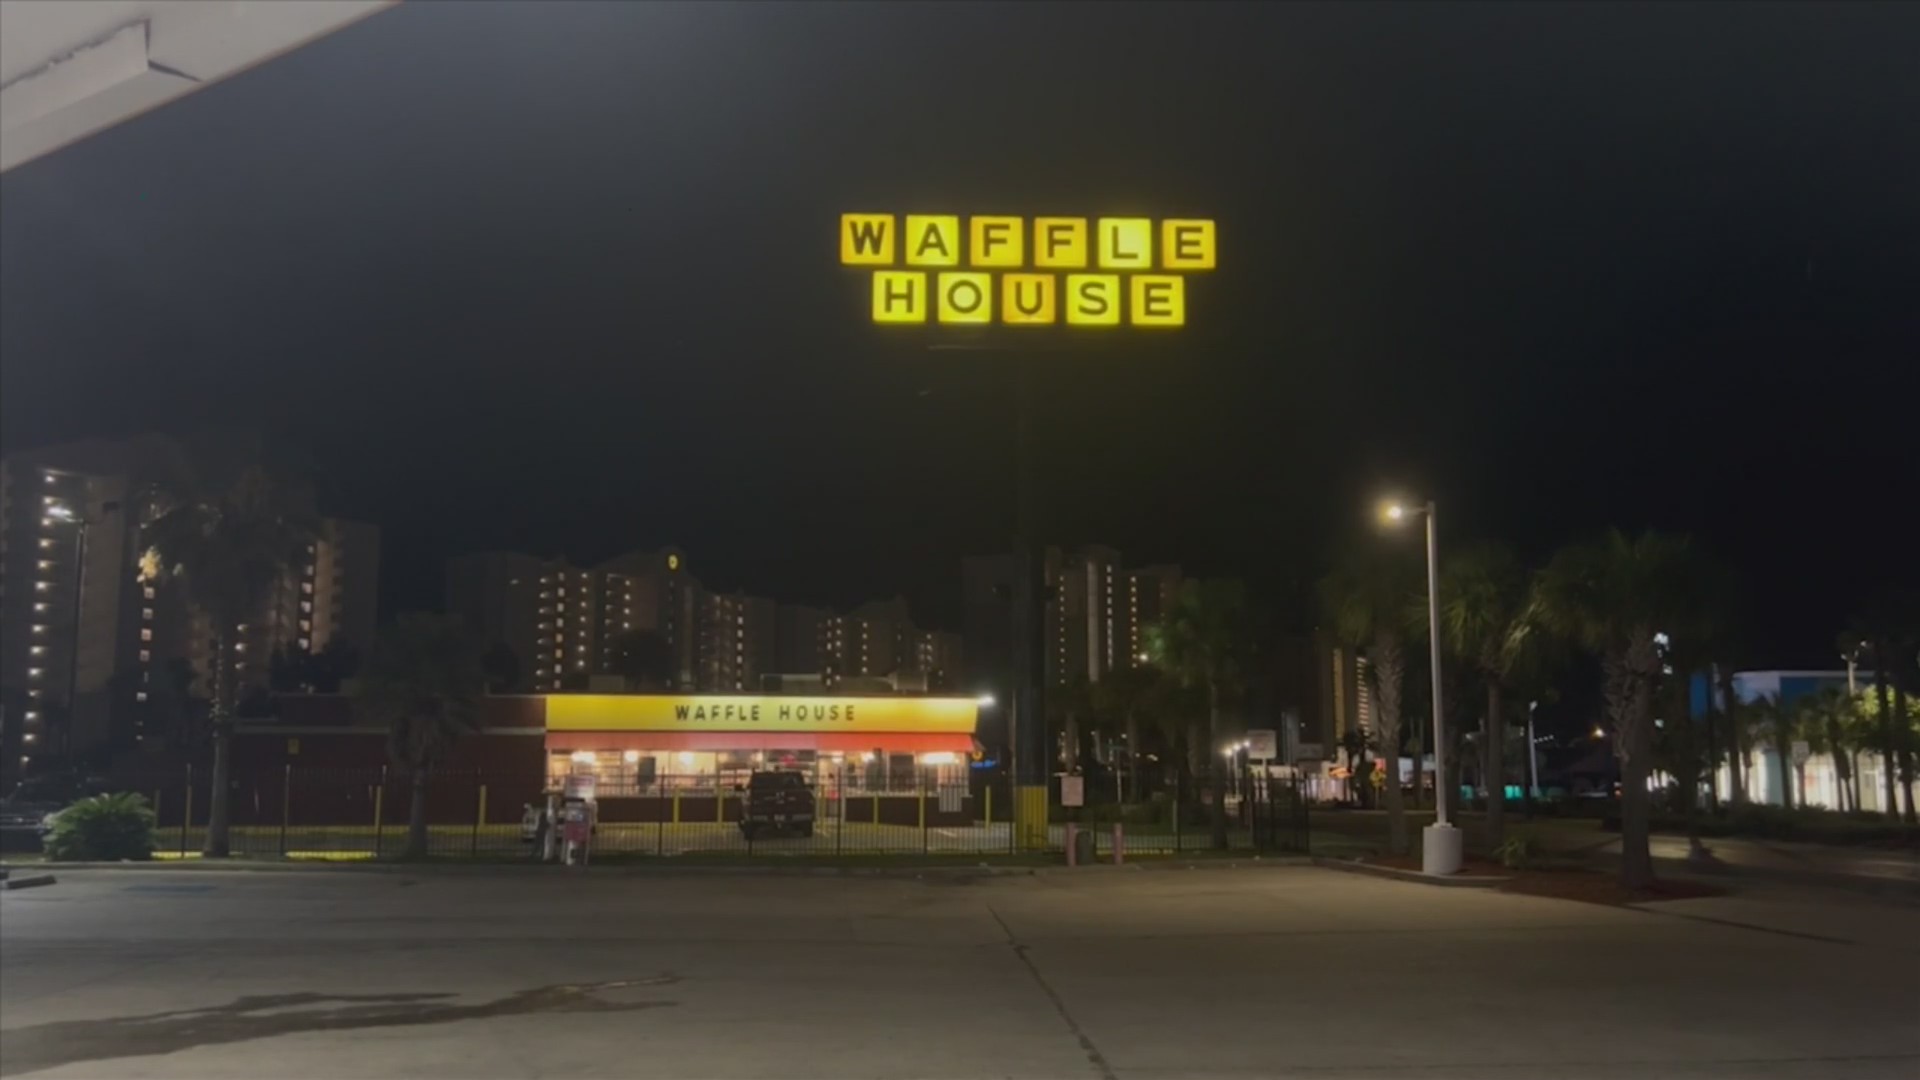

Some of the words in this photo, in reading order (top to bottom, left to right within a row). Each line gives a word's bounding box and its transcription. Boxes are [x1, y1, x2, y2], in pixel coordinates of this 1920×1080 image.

[849, 220, 1205, 261] WAFFLE
[884, 278, 1174, 317] HOUSE
[674, 704, 761, 722] WAFFLE
[778, 704, 856, 722] HOUSE
